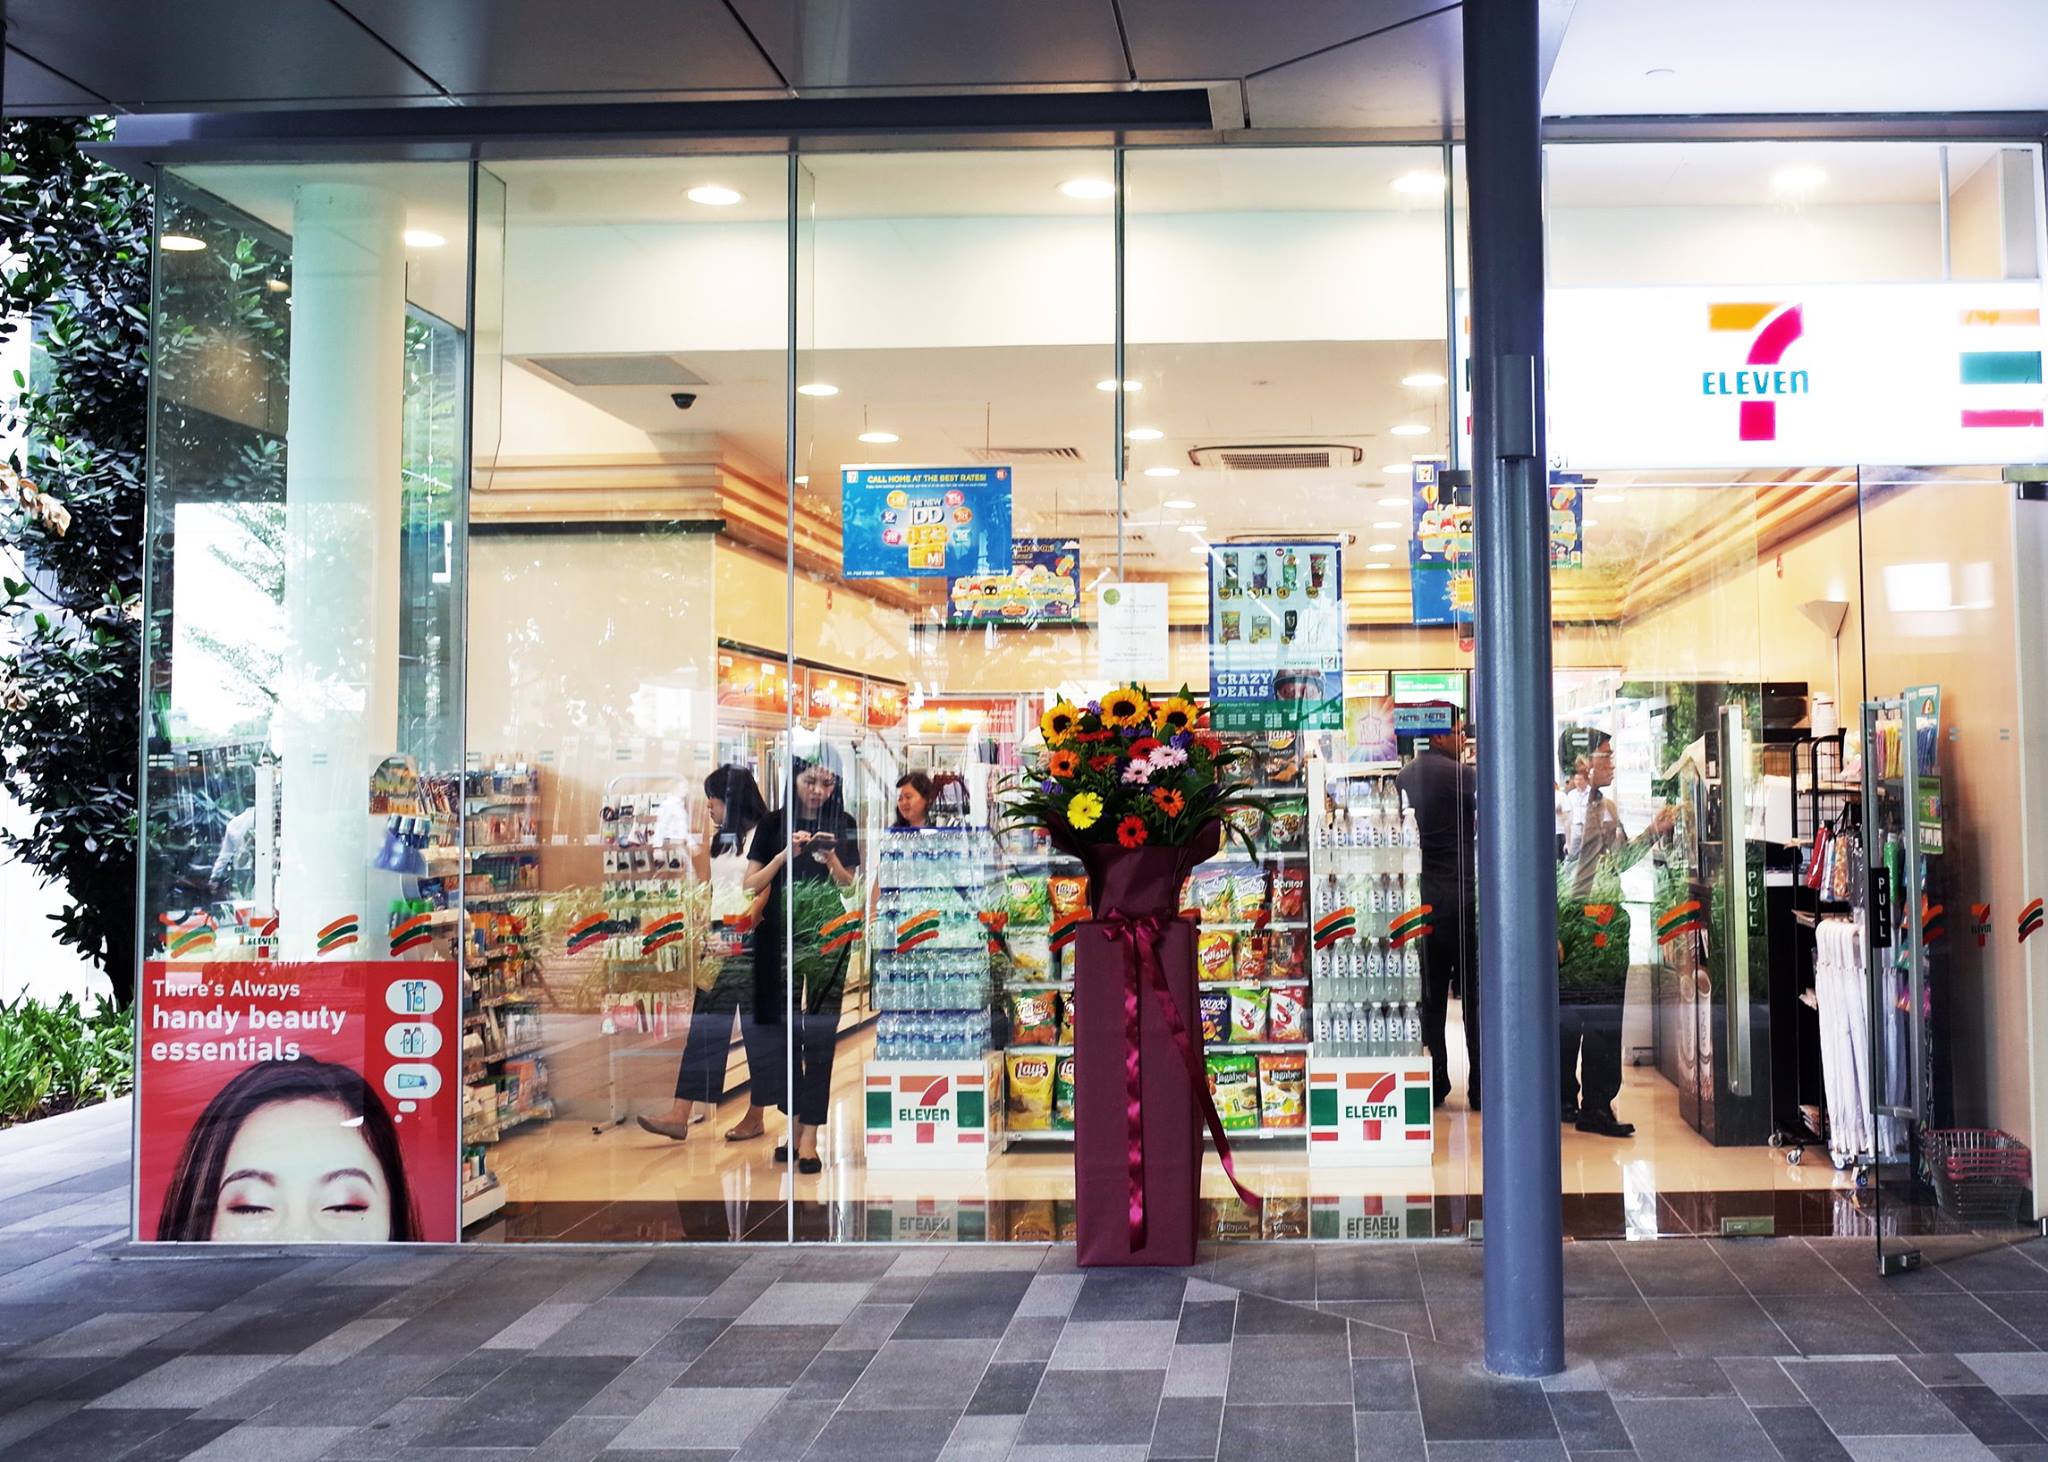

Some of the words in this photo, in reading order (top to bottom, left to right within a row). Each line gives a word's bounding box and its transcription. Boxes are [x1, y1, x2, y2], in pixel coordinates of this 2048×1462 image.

[867, 475, 888, 483] CALL
[888, 475, 911, 483] HOME
[912, 474, 922, 482] AT
[923, 474, 939, 482] THE
[940, 474, 960, 482] BEST
[1217, 673, 1271, 685] CRAZY
[1217, 685, 1269, 697] DEALS
[1748, 870, 1758, 928] PULL
[1878, 877, 1887, 938] PULL
[152, 979, 224, 997] There's
[230, 980, 301, 998] Always
[153, 1005, 240, 1035] handy
[249, 1005, 346, 1035] beauty
[151, 1037, 300, 1062] essentials
